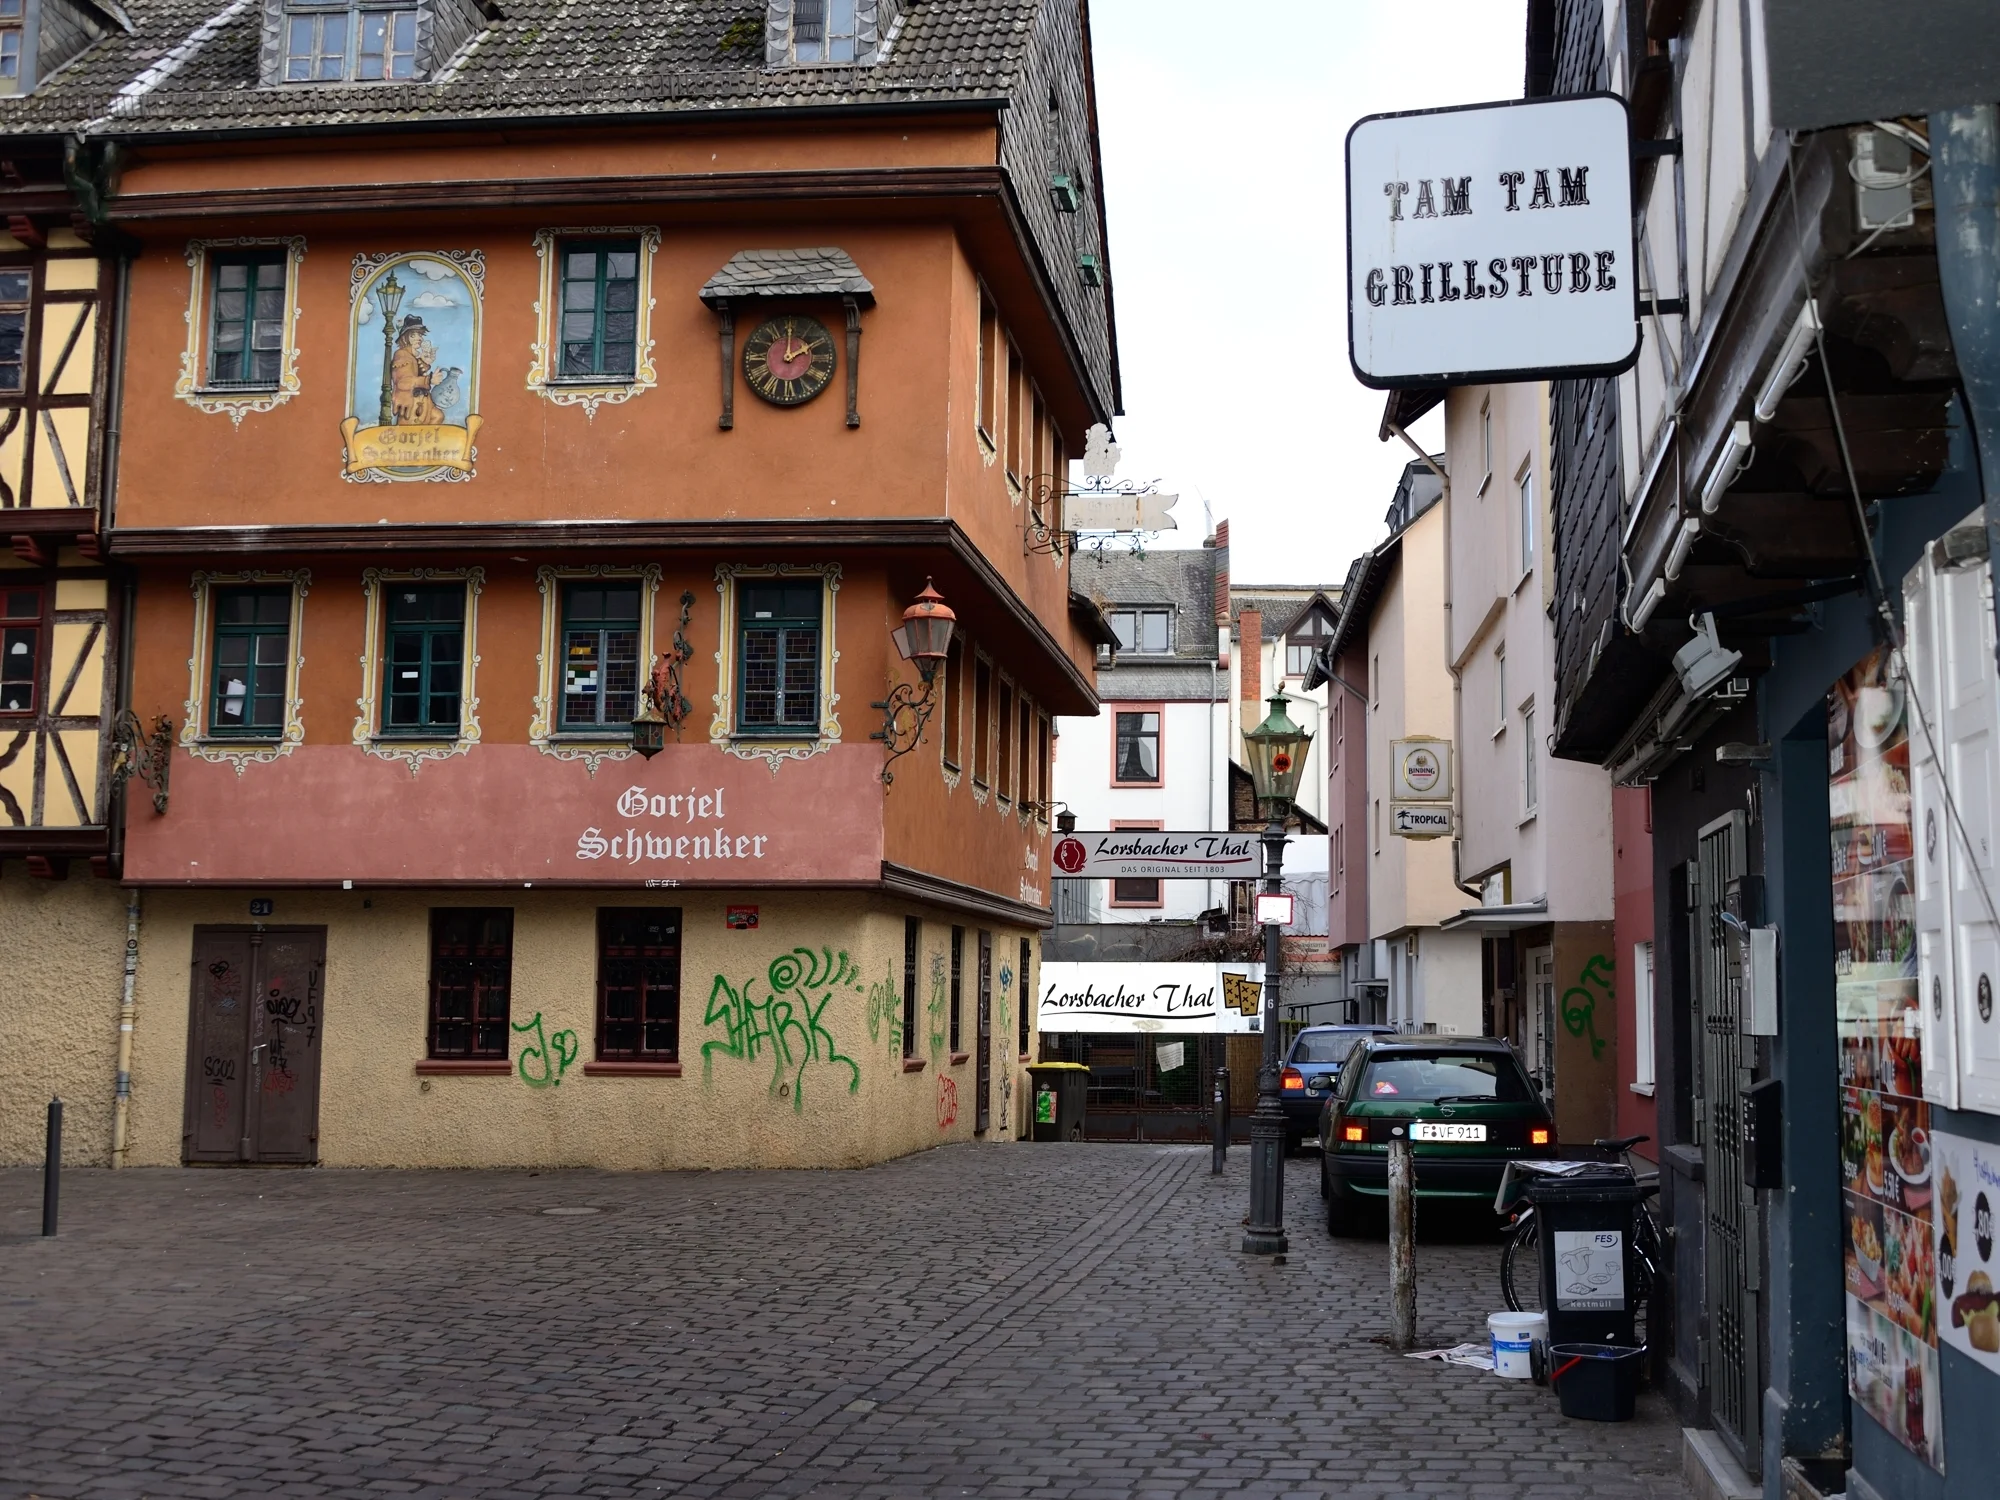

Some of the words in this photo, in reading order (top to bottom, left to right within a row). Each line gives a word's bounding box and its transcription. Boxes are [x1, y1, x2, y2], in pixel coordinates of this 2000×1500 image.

[1384, 176, 1473, 221] TAM
[1500, 166, 1590, 212] TAM
[1364, 250, 1617, 307] GRILLSTUBE
[1408, 767, 1436, 775] BINDING
[616, 785, 726, 824] Gorjel
[1410, 815, 1448, 825] TROPICAL
[576, 827, 769, 865] Schwenker
[1094, 837, 1188, 857] Lorsbacher
[1194, 837, 1250, 858] Thal
[1204, 866, 1225, 874] 1803
[251, 901, 270, 914] 21
[1041, 983, 1146, 1008] Lorsbacher
[1153, 984, 1215, 1012] Thal
[1267, 999, 1274, 1009] 6
[1422, 1126, 1429, 1138] F
[1439, 1127, 1455, 1139] VF
[1458, 1127, 1480, 1139] 911
[1594, 1234, 1613, 1243] FES
